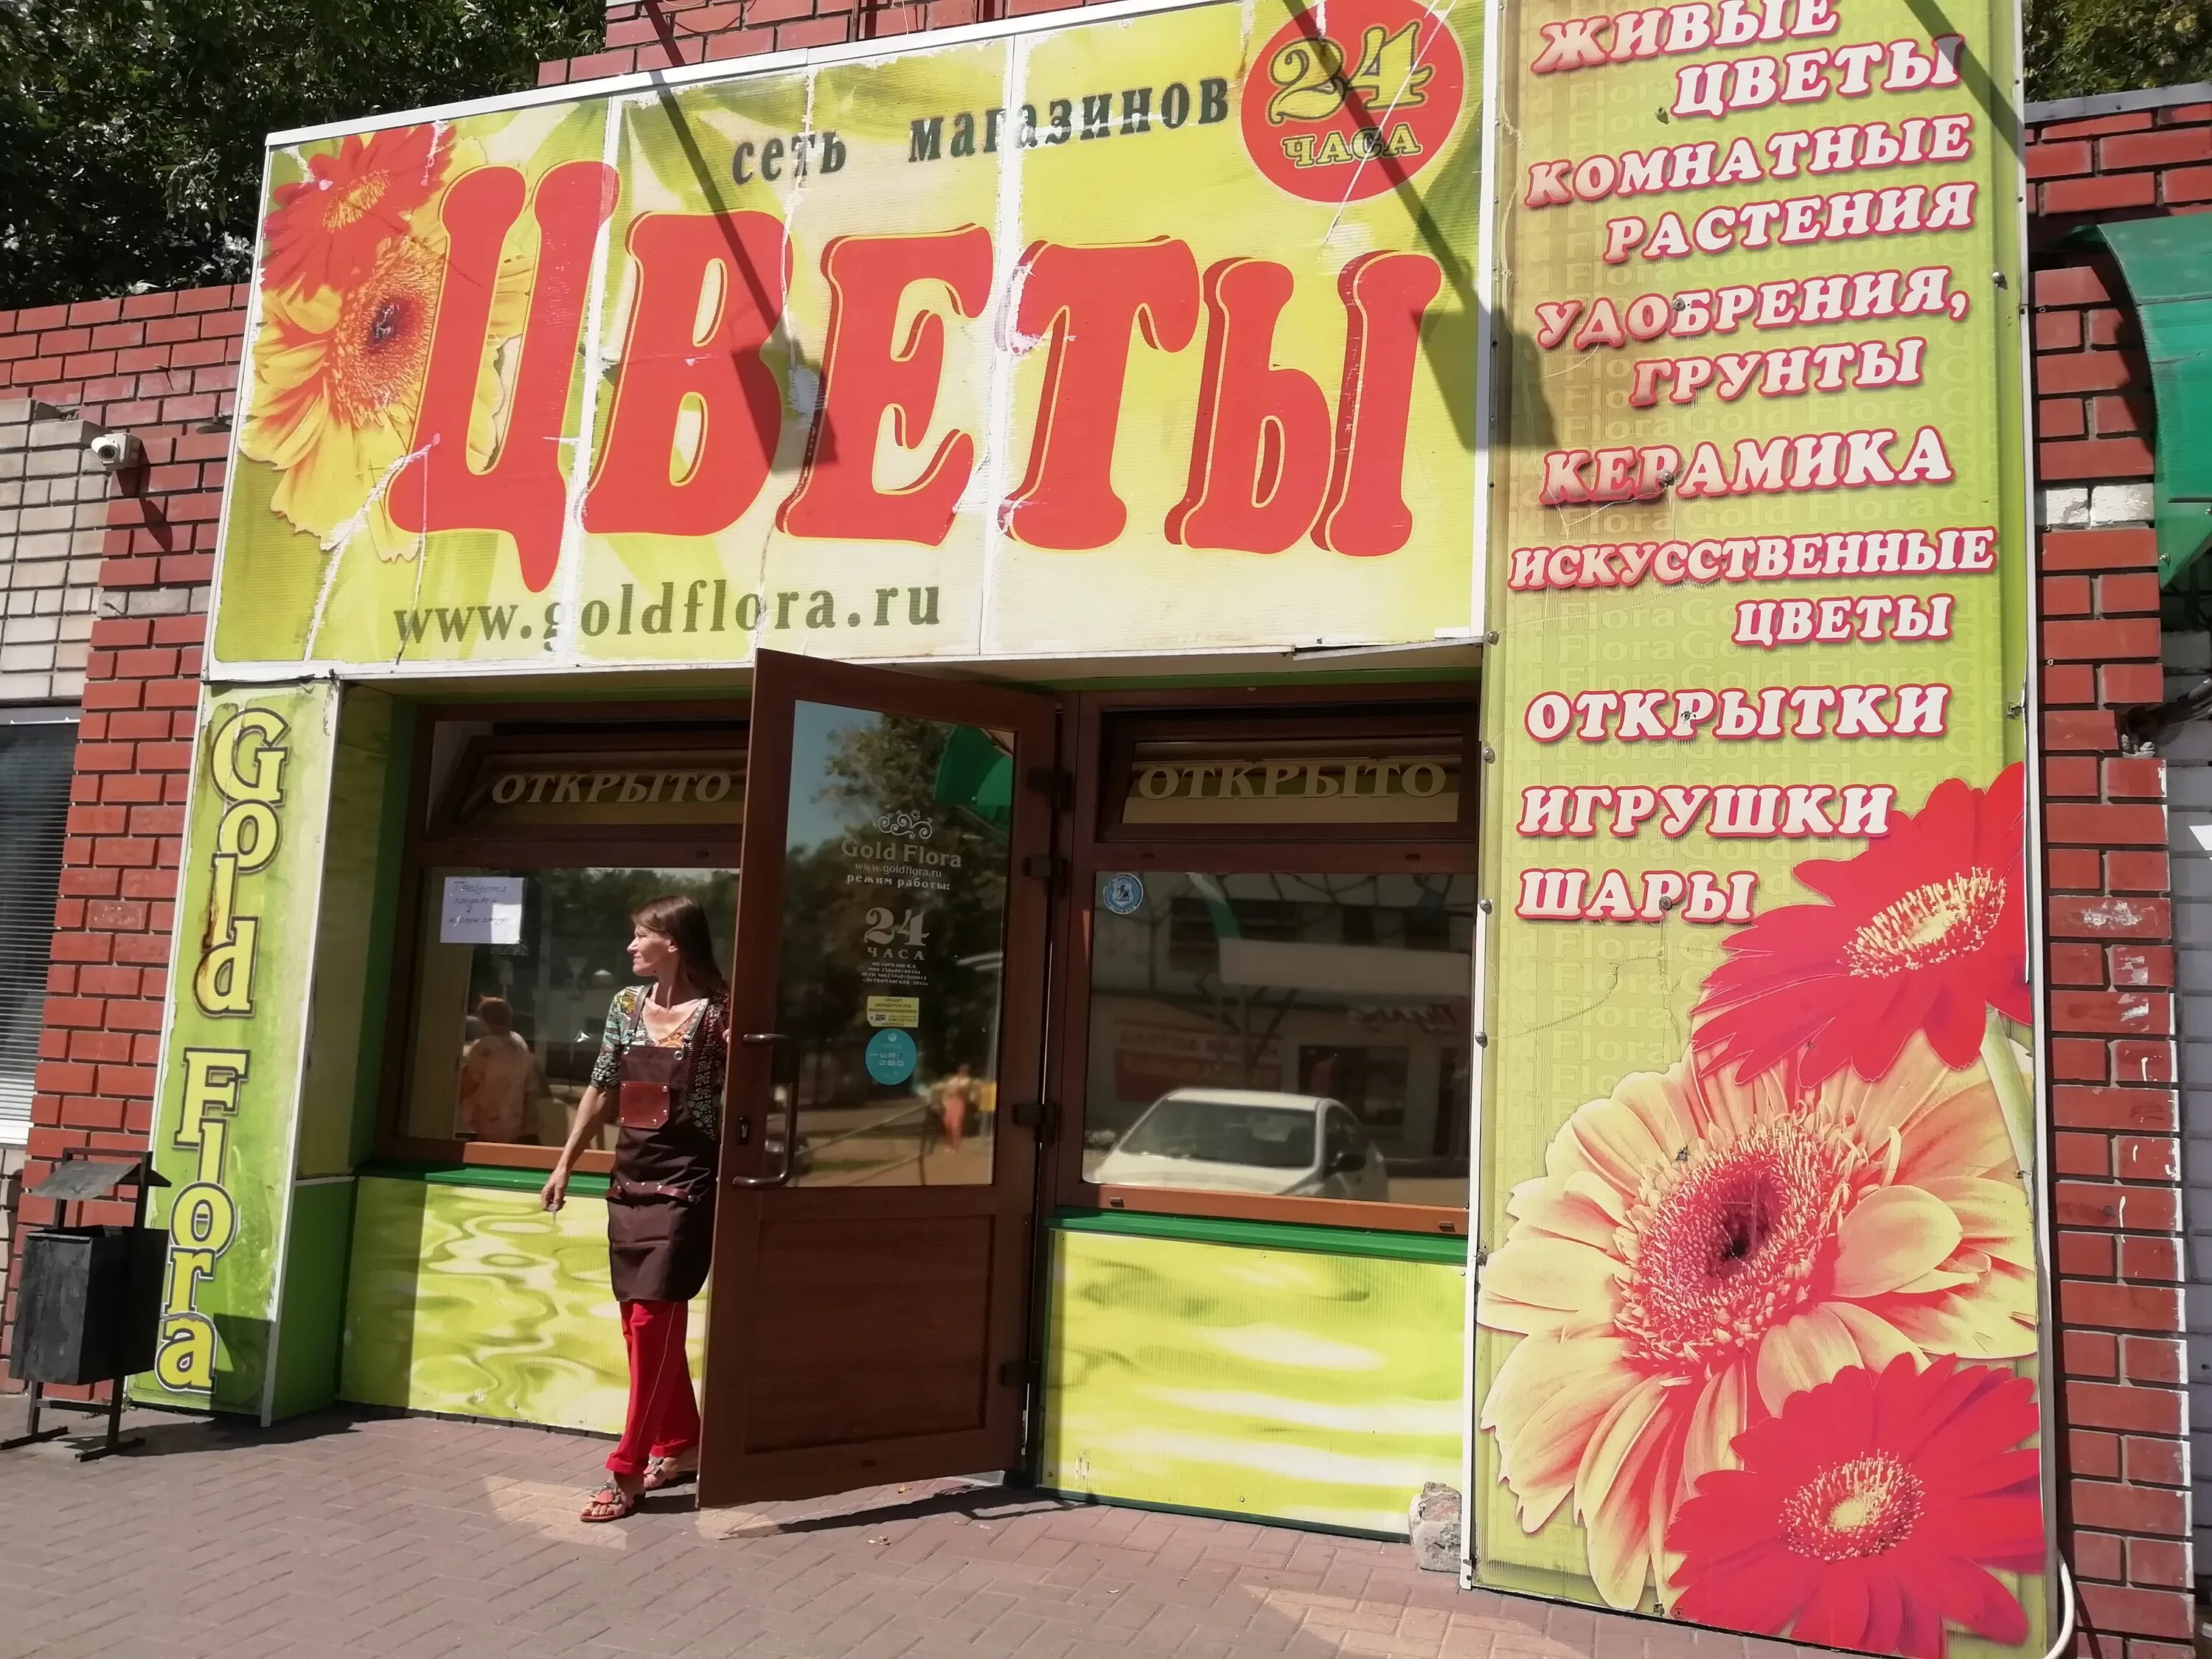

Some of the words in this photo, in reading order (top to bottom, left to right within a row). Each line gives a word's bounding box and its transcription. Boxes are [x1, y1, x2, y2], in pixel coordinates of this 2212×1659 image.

[1531, 0, 1839, 74] ЖИВЫЕ
[1268, 21, 1436, 126] 24
[1670, 34, 1964, 118] ЦВЕТЫ
[732, 130, 848, 186] сеть
[908, 77, 1229, 163] магазинов
[1281, 122, 1422, 169] ЧАСА
[1525, 113, 1974, 208] КОМНАТНЫЕ
[1603, 181, 1978, 262] РАСТЕНИЯ
[1535, 265, 1969, 350] УДОБРЕНИЯ,
[389, 159, 1447, 592] ЦВЕТЫ
[1629, 336, 1927, 407] ГРУНТЫ
[1539, 425, 1955, 506] КЕРАМИКА
[1507, 526, 1997, 591] ИСКУССТВЕННЫЕ
[393, 579, 941, 652] www.goldflora.ru
[1731, 594, 1955, 648] ЦВЕТЫ
[1524, 684, 1952, 743] ОТКРЫТКИ
[492, 771, 732, 804] ОТКРЫТО
[1138, 762, 1447, 799] ОТКРЫТО
[1516, 783, 1897, 838] ИГРУШКИ
[193, 706, 292, 1018] Gold
[841, 838, 896, 861] Gold
[903, 844, 961, 868] Flora
[846, 874, 893, 885] режим
[897, 877, 950, 891] работы:
[855, 863, 942, 877] www.goldflora.ru
[863, 907, 931, 947] 24
[1514, 868, 1759, 924] ШАРЫ
[867, 947, 925, 961] ЧАСА
[156, 1046, 251, 1394] Flora
